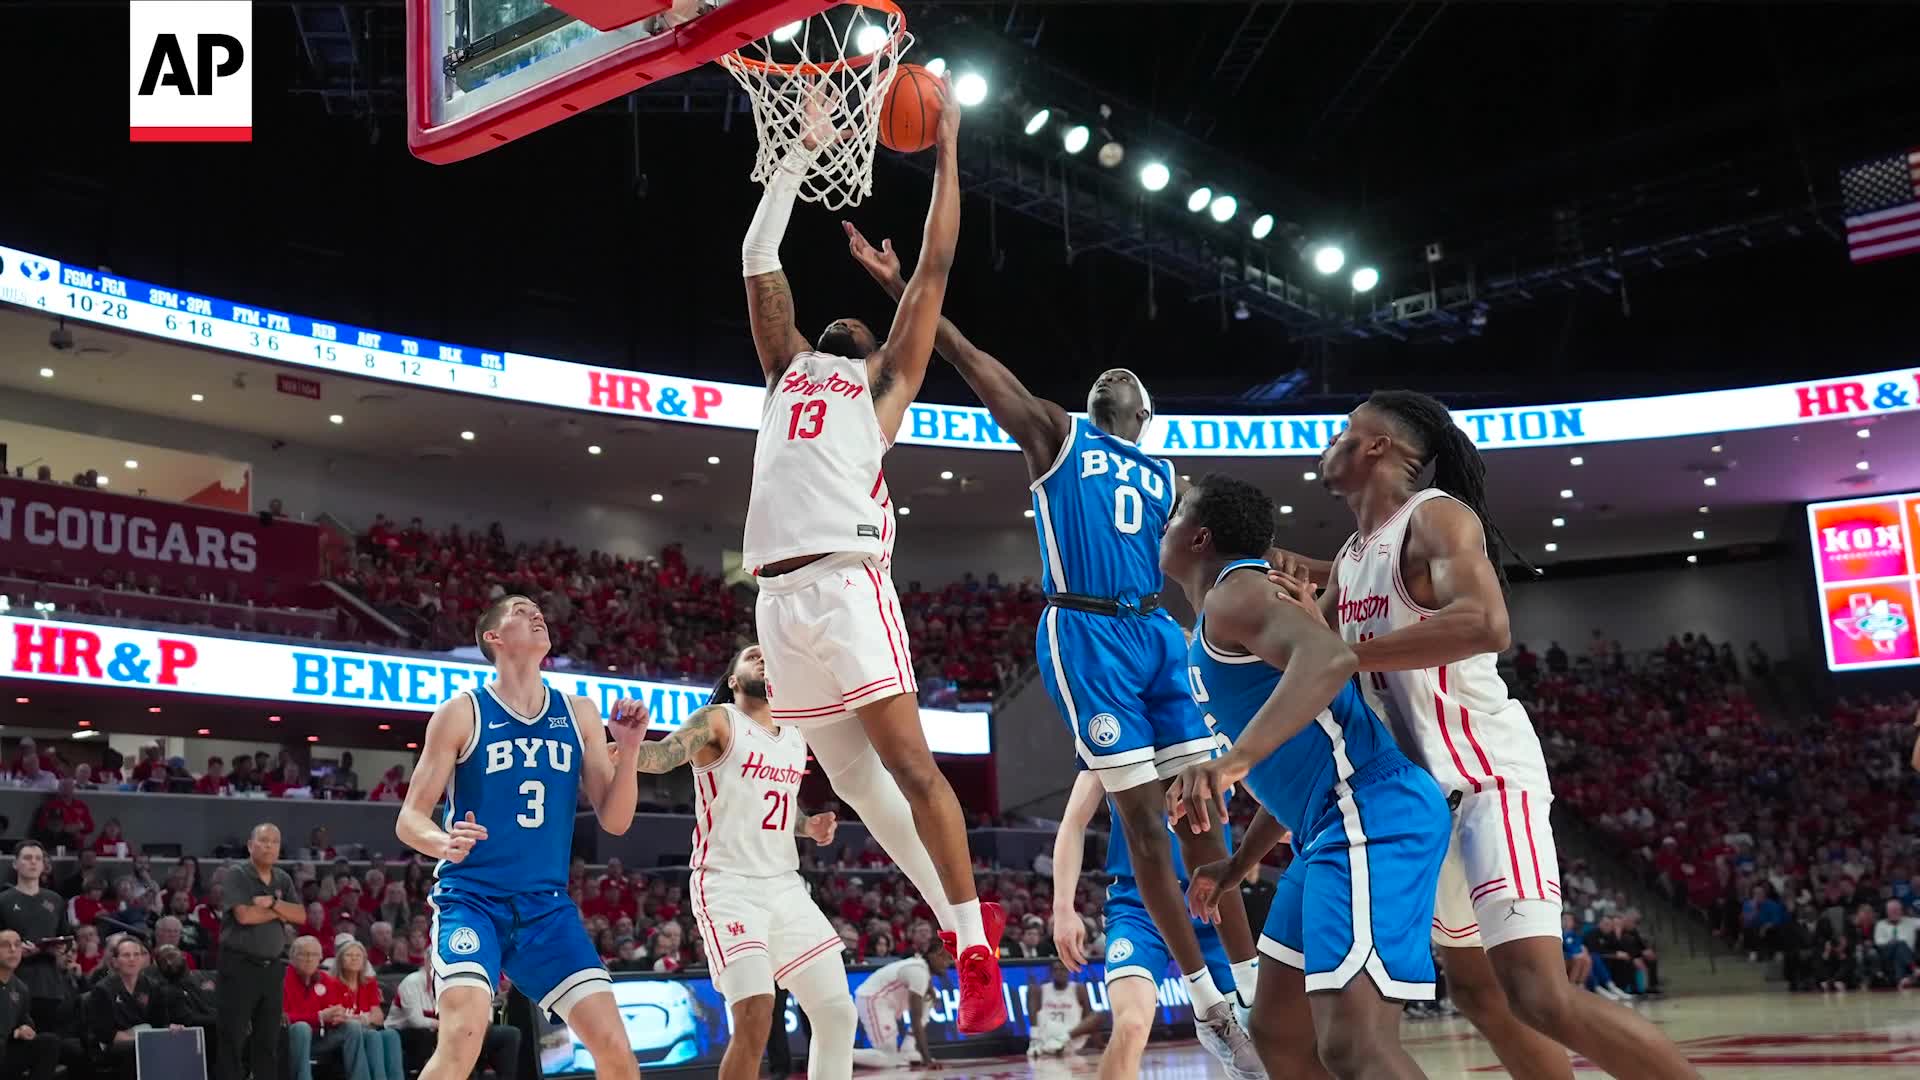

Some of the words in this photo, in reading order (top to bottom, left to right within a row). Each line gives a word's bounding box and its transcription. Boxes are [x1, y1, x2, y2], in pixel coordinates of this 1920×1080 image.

[313, 344, 337, 362] 15
[364, 352, 376, 369] 8
[400, 360, 422, 376] 12
[448, 367, 456, 382] 1
[488, 373, 498, 389] 3
[401, 339, 419, 355] TO
[787, 399, 827, 440] 13
[1081, 450, 1164, 500] BYU
[1114, 485, 1143, 535] 0
[24, 501, 257, 572] COUGARS
[1337, 585, 1389, 624] Houston
[485, 737, 573, 775] BYU
[516, 780, 545, 828] 3
[761, 790, 788, 831] 21
